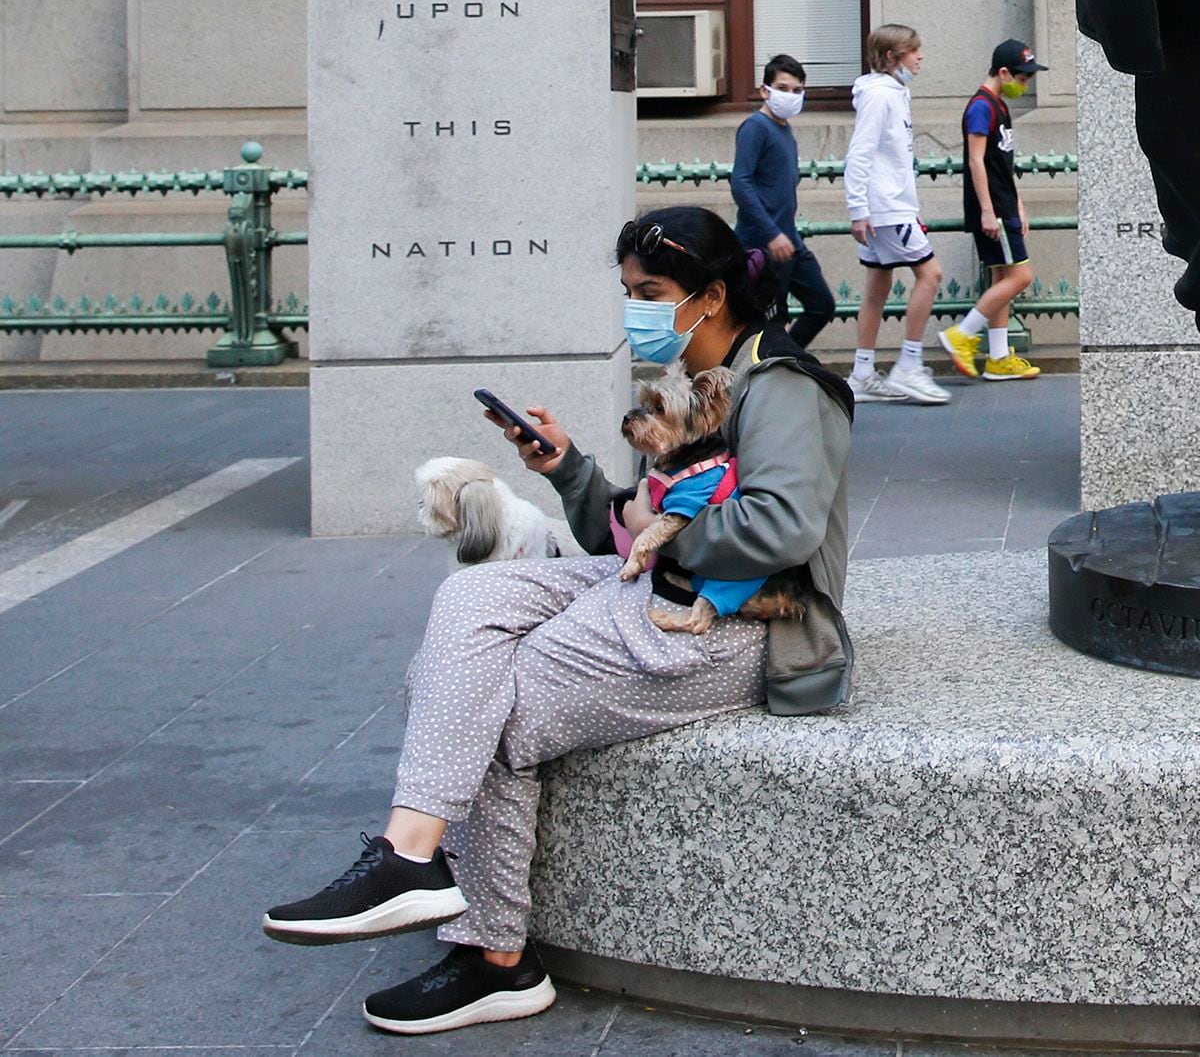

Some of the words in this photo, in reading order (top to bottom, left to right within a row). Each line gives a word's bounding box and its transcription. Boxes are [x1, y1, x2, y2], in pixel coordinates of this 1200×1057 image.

[395, 1, 521, 20] UPON
[403, 119, 513, 138] THIS
[371, 238, 549, 259] NATION
